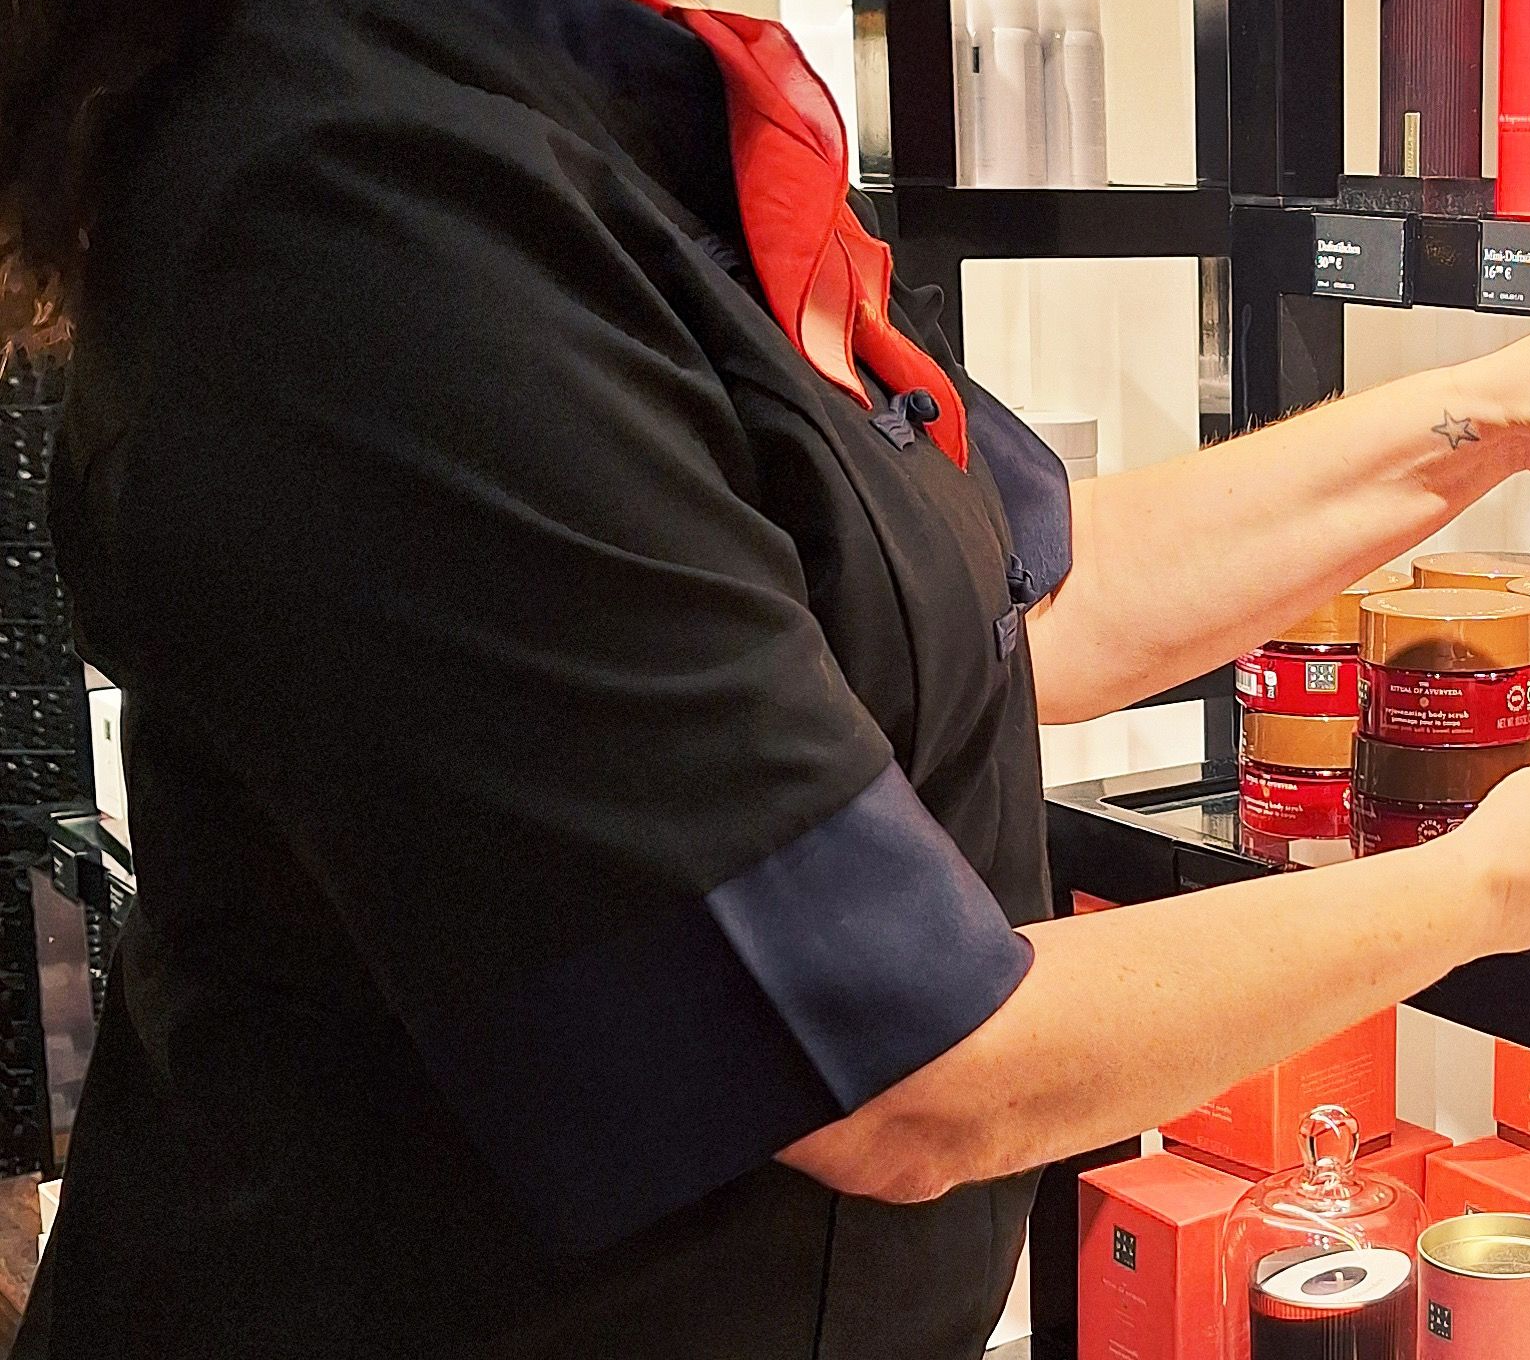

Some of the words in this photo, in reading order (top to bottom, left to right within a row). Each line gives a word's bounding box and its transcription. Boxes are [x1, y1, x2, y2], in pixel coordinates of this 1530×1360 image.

[1423, 688, 1464, 697] AYURVEDA
[1427, 711, 1447, 721] body
[1447, 710, 1470, 720] scrub
